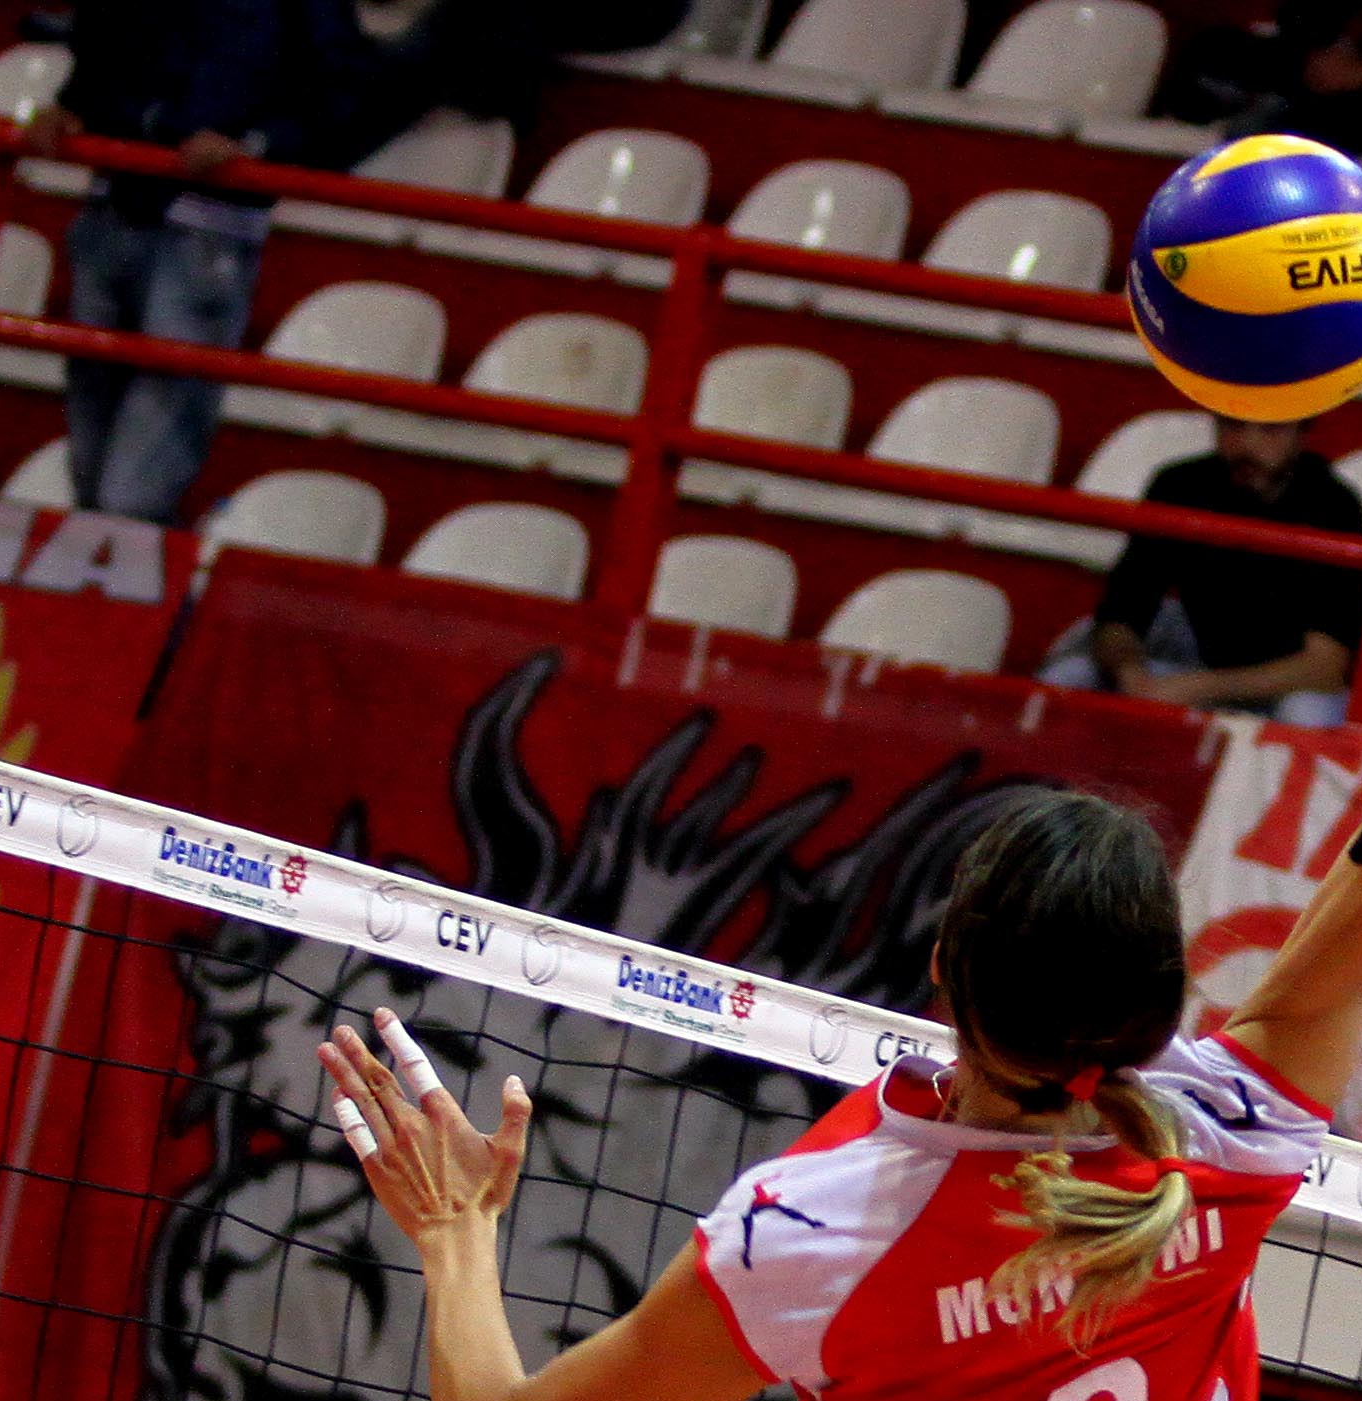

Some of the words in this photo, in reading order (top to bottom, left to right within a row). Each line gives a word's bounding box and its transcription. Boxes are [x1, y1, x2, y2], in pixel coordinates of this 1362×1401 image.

[160, 826, 274, 890] DenizBank
[437, 908, 496, 958] CEV
[617, 954, 725, 1016] DenizBank
